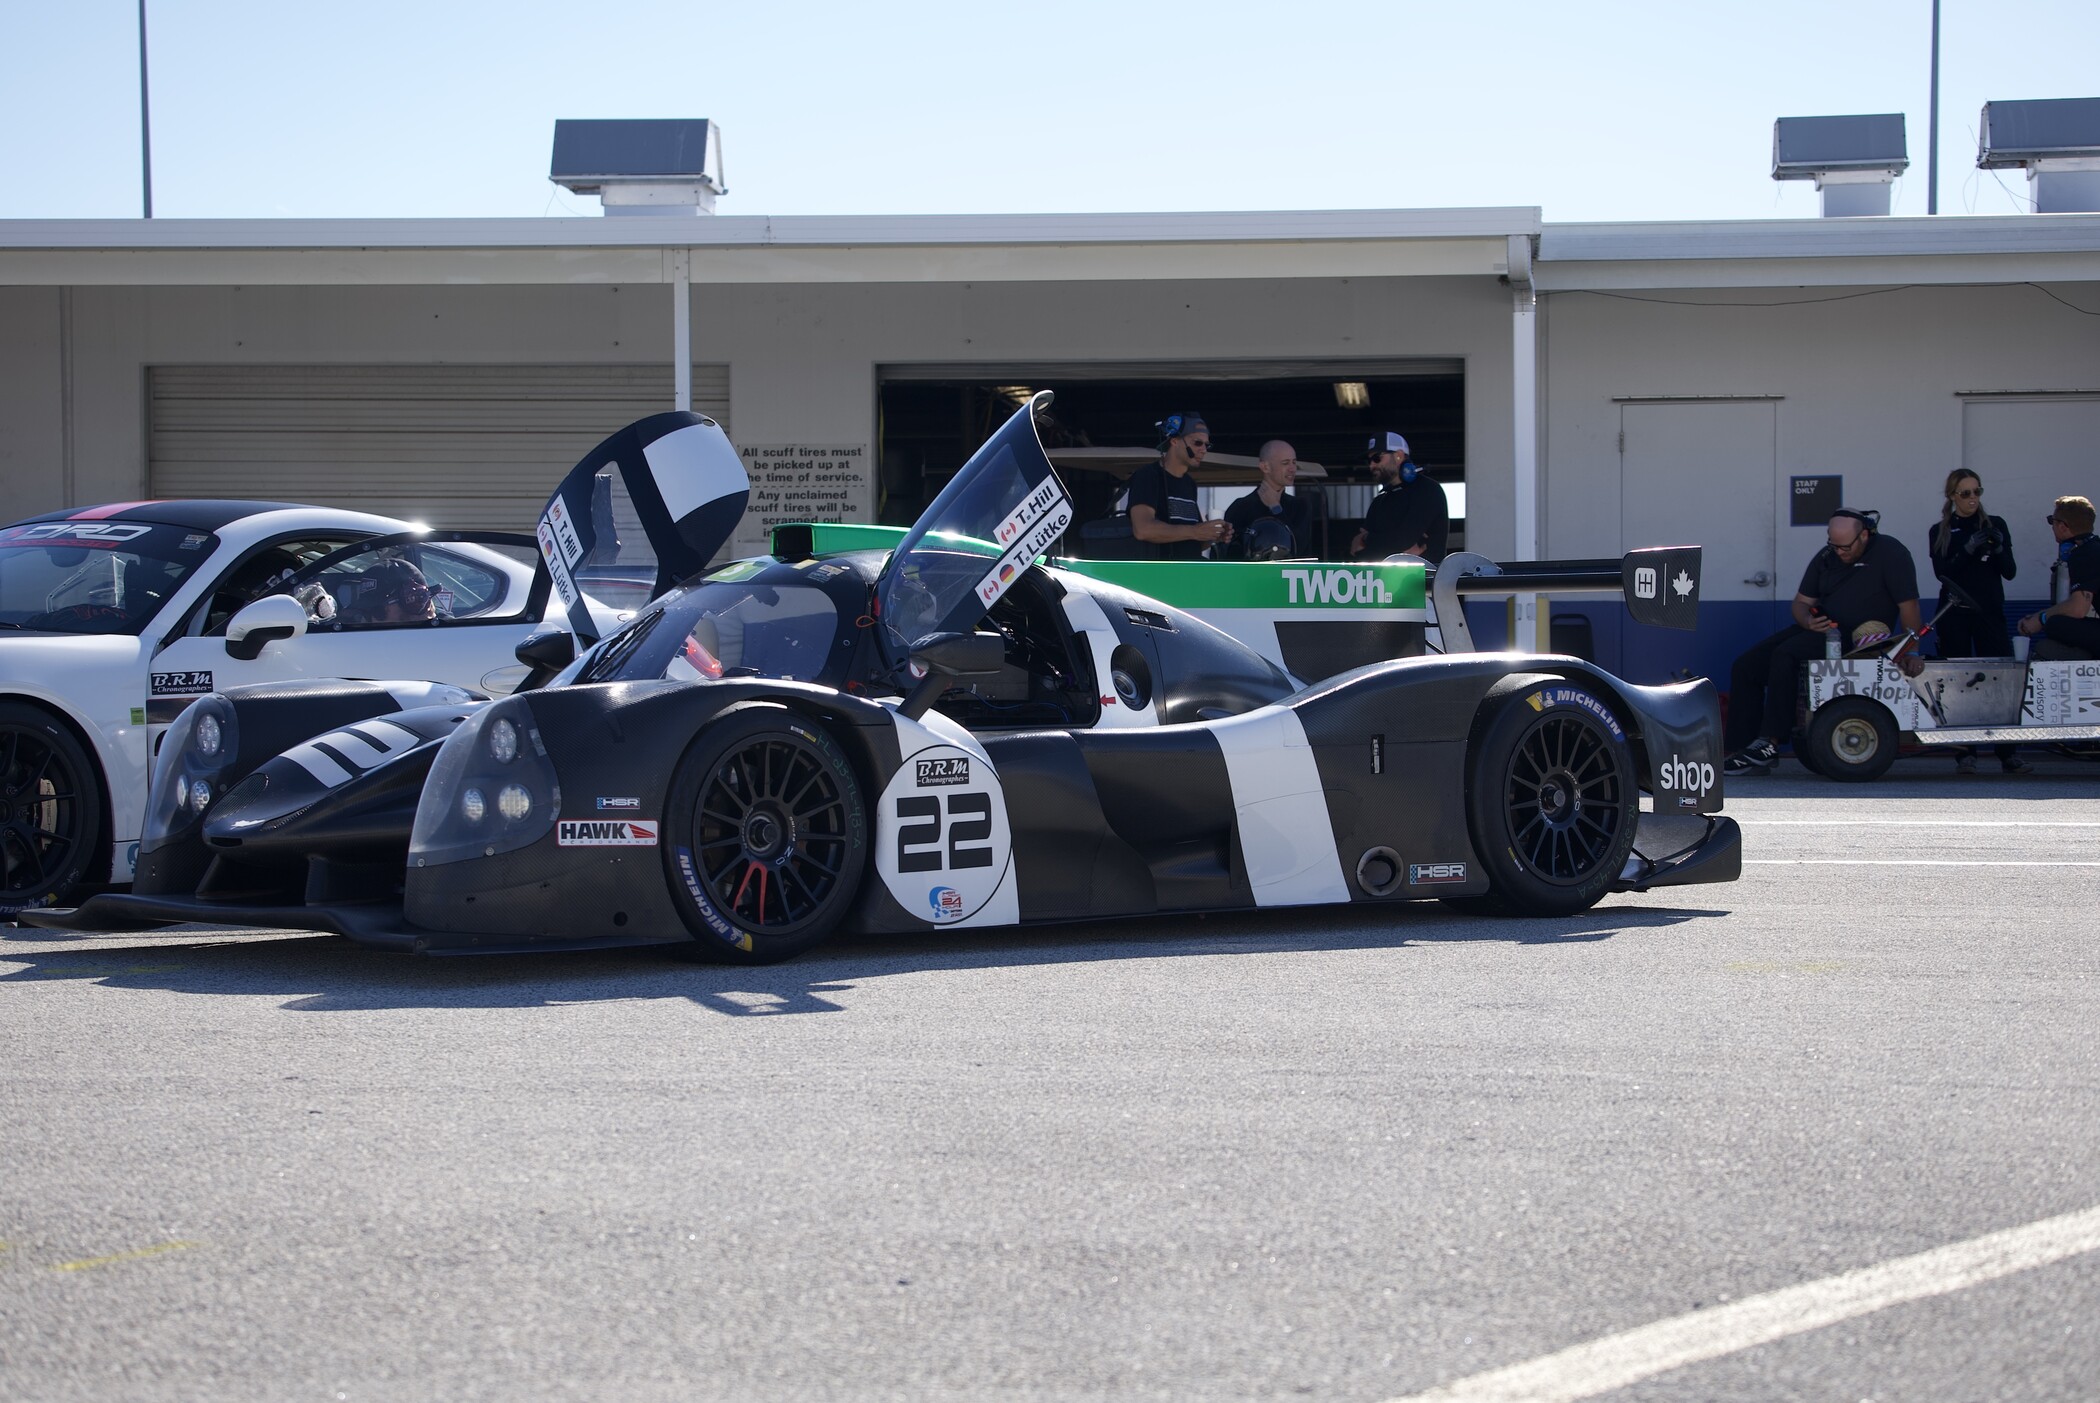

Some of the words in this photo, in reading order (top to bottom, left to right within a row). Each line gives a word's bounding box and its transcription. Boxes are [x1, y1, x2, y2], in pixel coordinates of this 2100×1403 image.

[742, 447, 758, 457] All
[763, 447, 794, 457] scuff
[799, 447, 827, 457] tires
[831, 447, 862, 457] must
[753, 460, 769, 470] be
[773, 460, 813, 471] picked
[817, 461, 833, 471] up
[837, 460, 850, 470] at
[747, 473, 762, 482] he
[766, 472, 794, 482] time
[797, 472, 811, 482] of
[815, 472, 863, 482] service.
[757, 490, 781, 502] Any
[784, 489, 848, 500] unclaimed
[1795, 487, 1816, 495] ONLY
[747, 503, 779, 512] scuff
[783, 503, 812, 512] tires
[816, 502, 838, 512] will
[842, 502, 857, 512] be
[2035, 677, 2047, 722] advisory
[1556, 690, 1622, 735] MICHELIN
[1660, 753, 1715, 798] shop
[602, 798, 639, 806] HSR
[560, 822, 627, 840] HAWK
[896, 791, 993, 874] 22
[1417, 864, 1465, 879] HSR
[679, 853, 729, 935] MICHELIN
